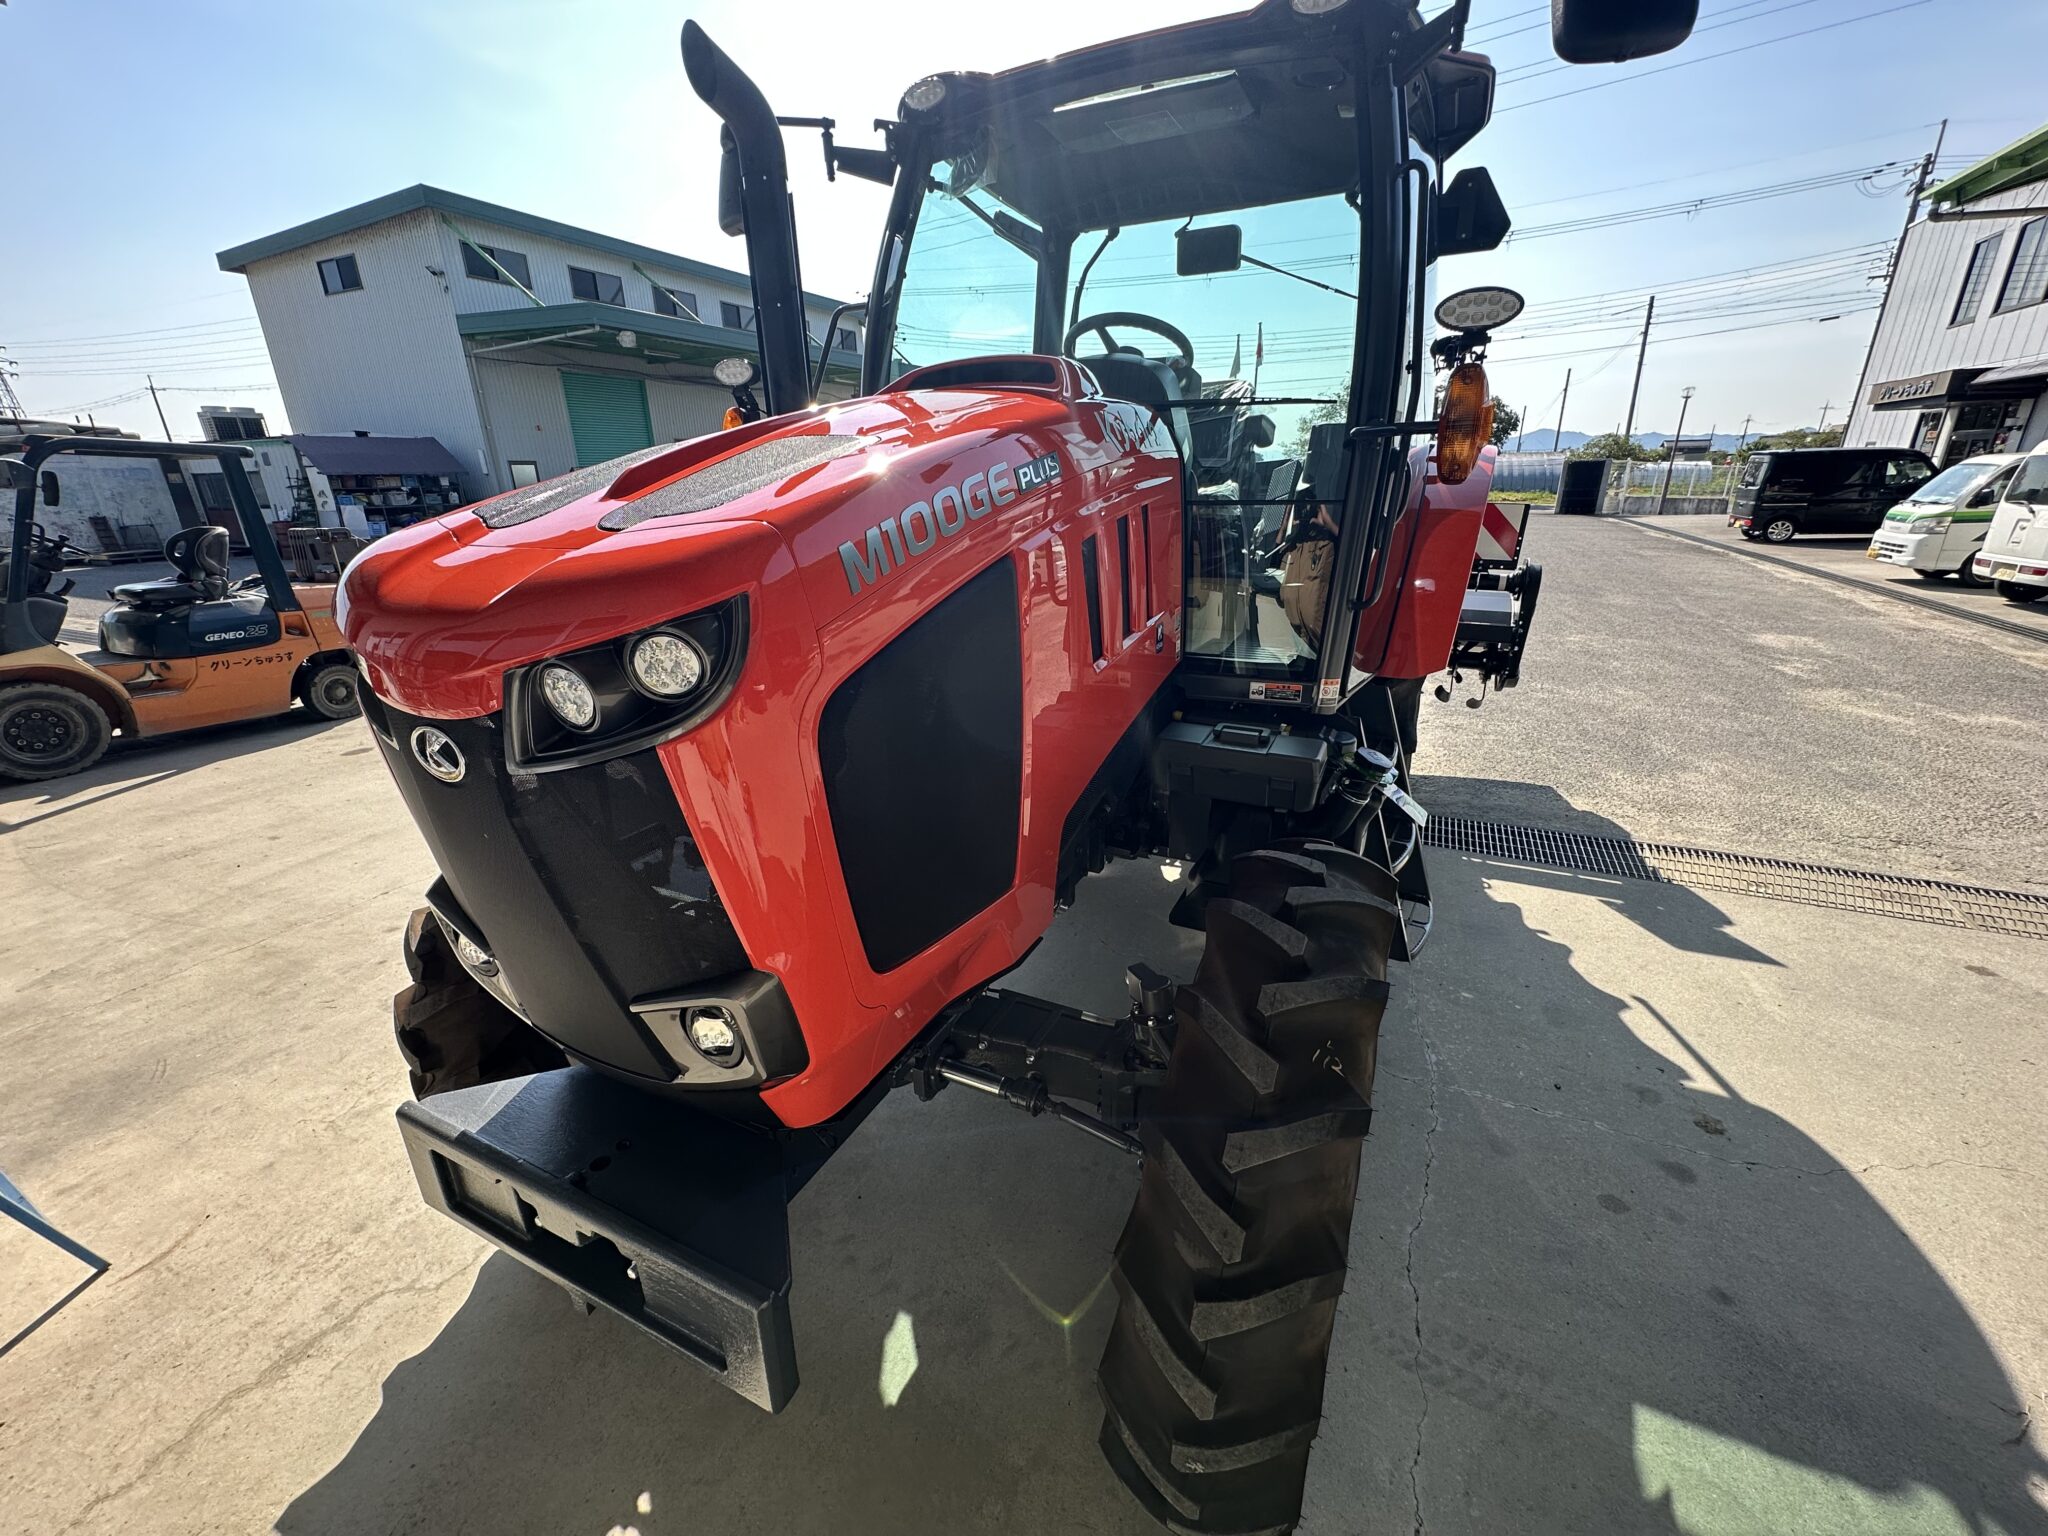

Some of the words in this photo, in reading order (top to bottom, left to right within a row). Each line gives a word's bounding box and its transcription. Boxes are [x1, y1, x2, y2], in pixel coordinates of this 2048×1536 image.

[838, 461, 1016, 597] M100GE
[1017, 456, 1061, 490] PLUS
[204, 630, 245, 642] GENEO
[245, 623, 269, 638] 25
[210, 651, 294, 672] グリーンちゅうず
